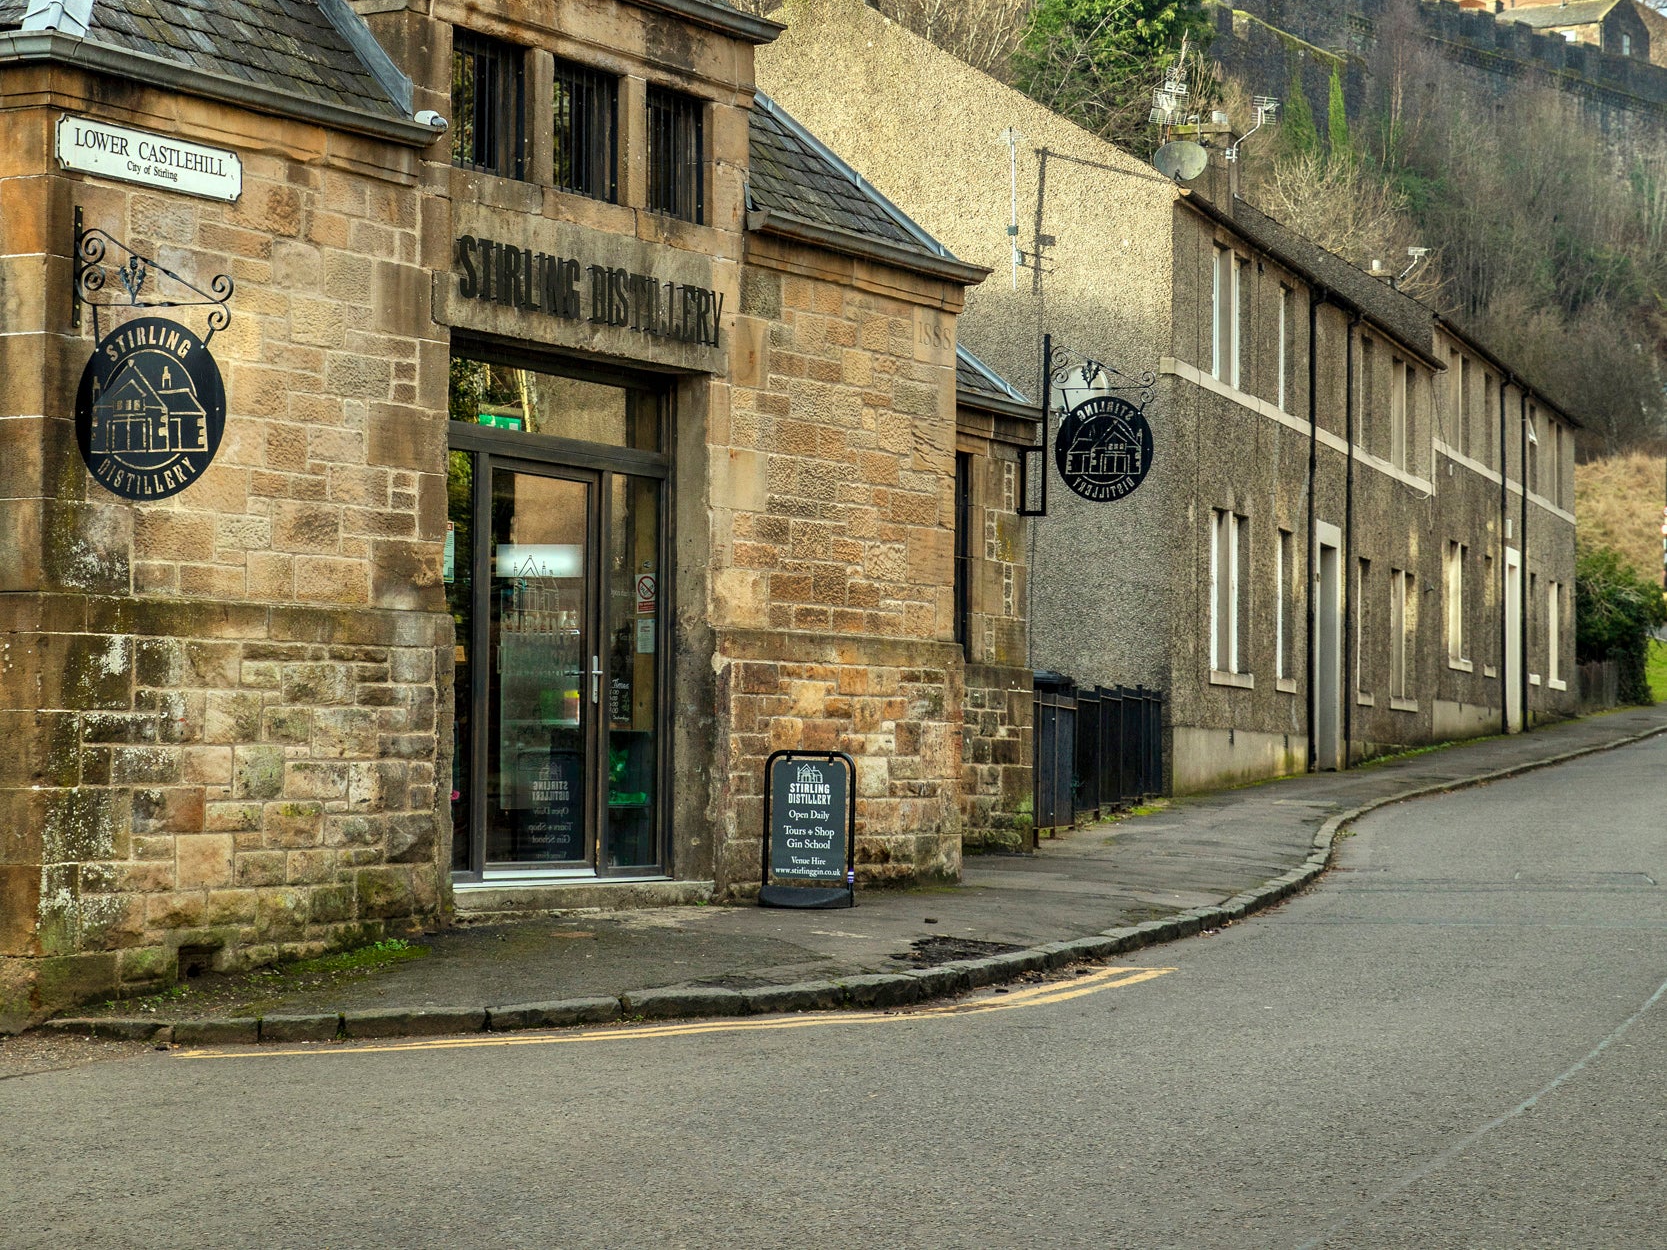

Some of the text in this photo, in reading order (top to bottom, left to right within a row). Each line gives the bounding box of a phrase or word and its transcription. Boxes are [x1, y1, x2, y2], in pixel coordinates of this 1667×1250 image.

[75, 127, 227, 178] LOWER CASTLEHILL
[127, 161, 178, 182] City of Stirling
[459, 234, 724, 348] STIRLING DISTILLERY
[106, 325, 192, 362] STIRLING
[97, 455, 196, 495] DISTILLERY
[789, 783, 830, 794] STIRLING
[788, 793, 831, 805] DISTILLERY
[788, 809, 830, 822] Open Daily
[783, 825, 806, 835] Tours
[814, 826, 835, 839] Shop
[786, 838, 831, 849] Gin School
[791, 856, 826, 865] Venue Hire
[775, 867, 841, 877] www.stirlinggin.co.uk
